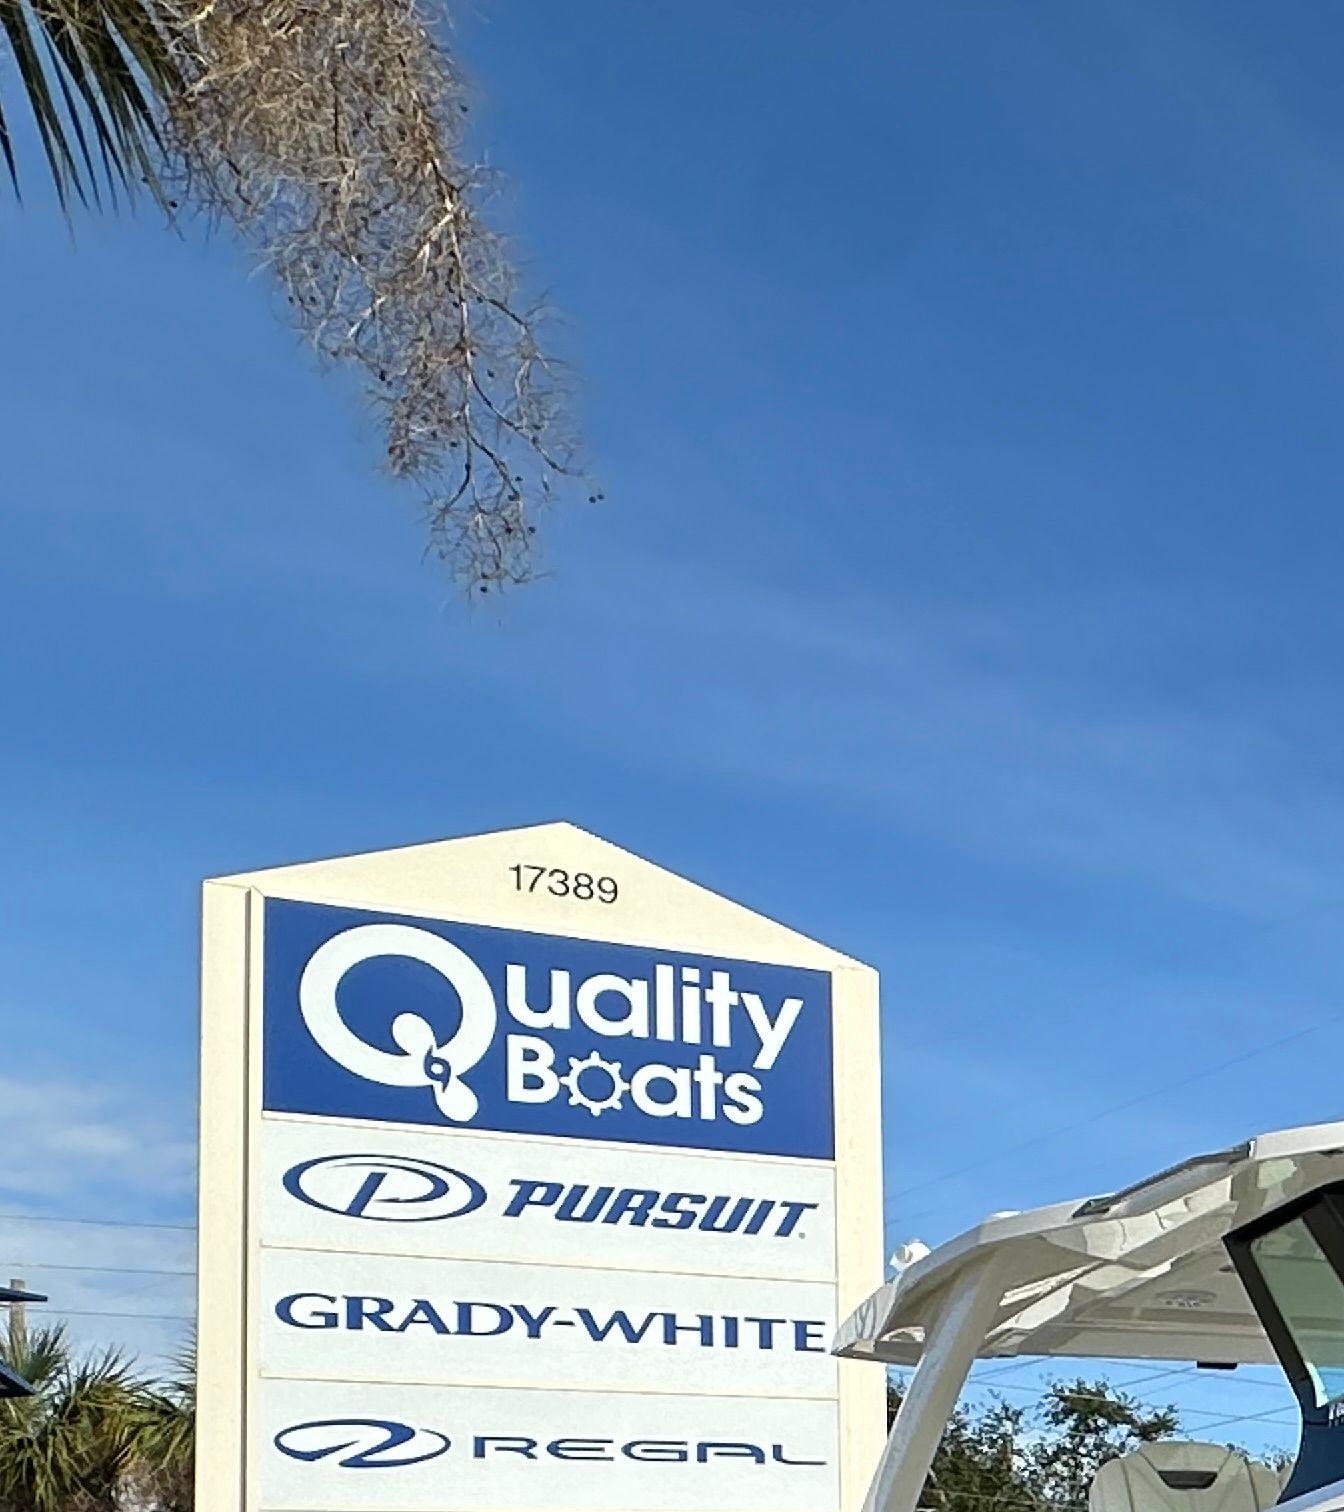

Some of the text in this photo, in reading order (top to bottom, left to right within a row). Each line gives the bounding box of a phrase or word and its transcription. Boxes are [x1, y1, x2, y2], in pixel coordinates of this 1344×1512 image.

[508, 864, 619, 904] 17389
[506, 1035, 763, 1124] Boats
[502, 1177, 818, 1238] PURSUIT
[274, 1292, 826, 1352] GRADY-WHITE
[472, 1436, 826, 1466] REGAL
